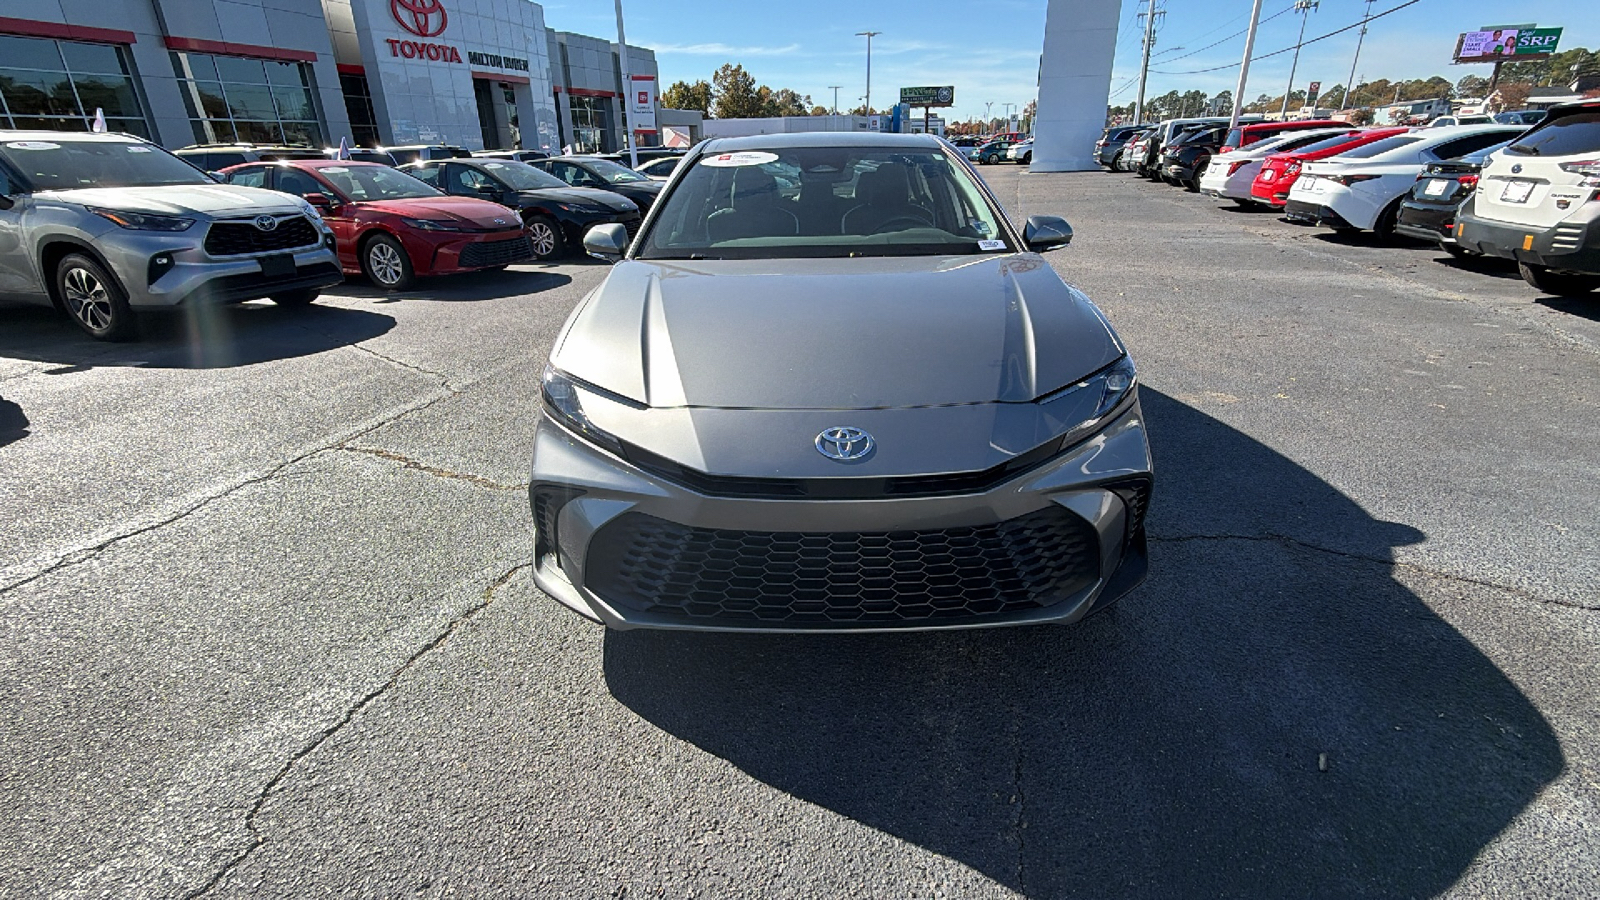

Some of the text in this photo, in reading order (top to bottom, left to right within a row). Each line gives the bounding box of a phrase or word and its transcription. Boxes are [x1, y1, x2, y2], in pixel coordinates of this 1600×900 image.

[1518, 36, 1557, 46] SRP
[387, 38, 463, 64] TOYOTA
[468, 51, 503, 68] MILTON
